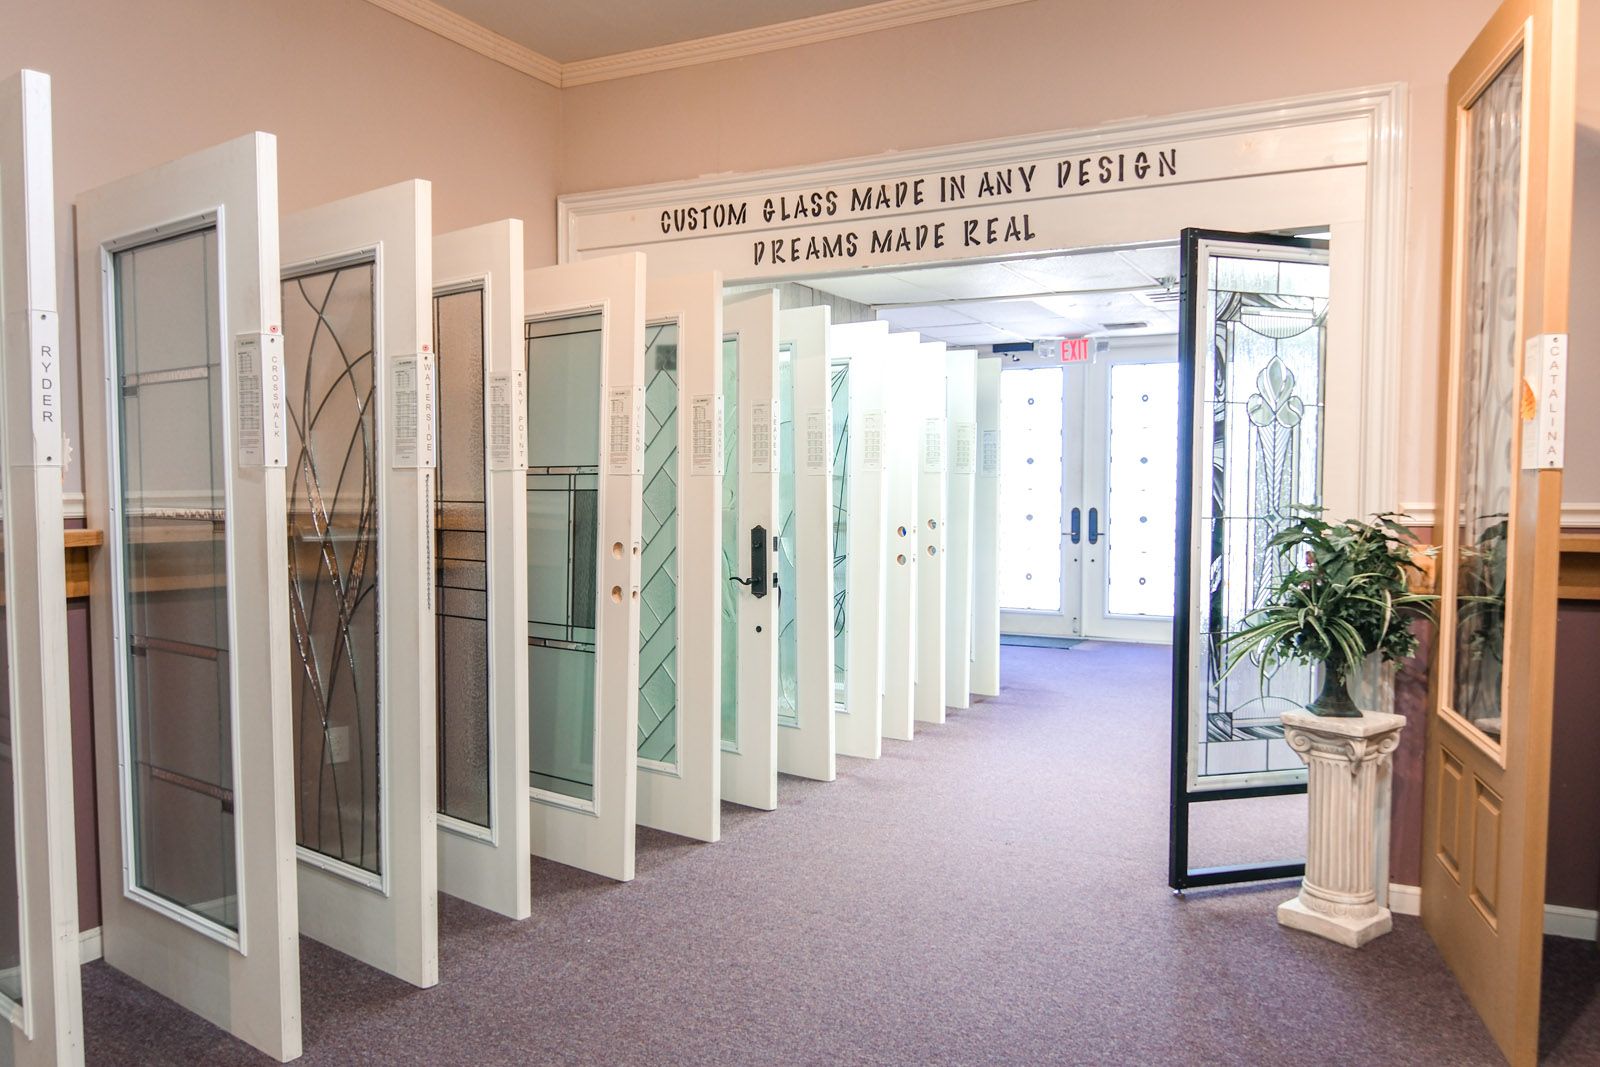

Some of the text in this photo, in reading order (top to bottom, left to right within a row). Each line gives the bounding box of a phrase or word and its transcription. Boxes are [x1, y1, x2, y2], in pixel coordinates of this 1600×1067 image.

[661, 149, 1176, 233] CUSTOM GLASS MADE IN ANY DESIGN
[754, 215, 1035, 265] DREAMS MADE REAL
[41, 345, 53, 422] RYDER
[1061, 339, 1089, 362] EXIT
[271, 356, 281, 438] CROSSWALK
[423, 363, 433, 452] WATERSIDE
[1547, 346, 1560, 455] CATALINA
